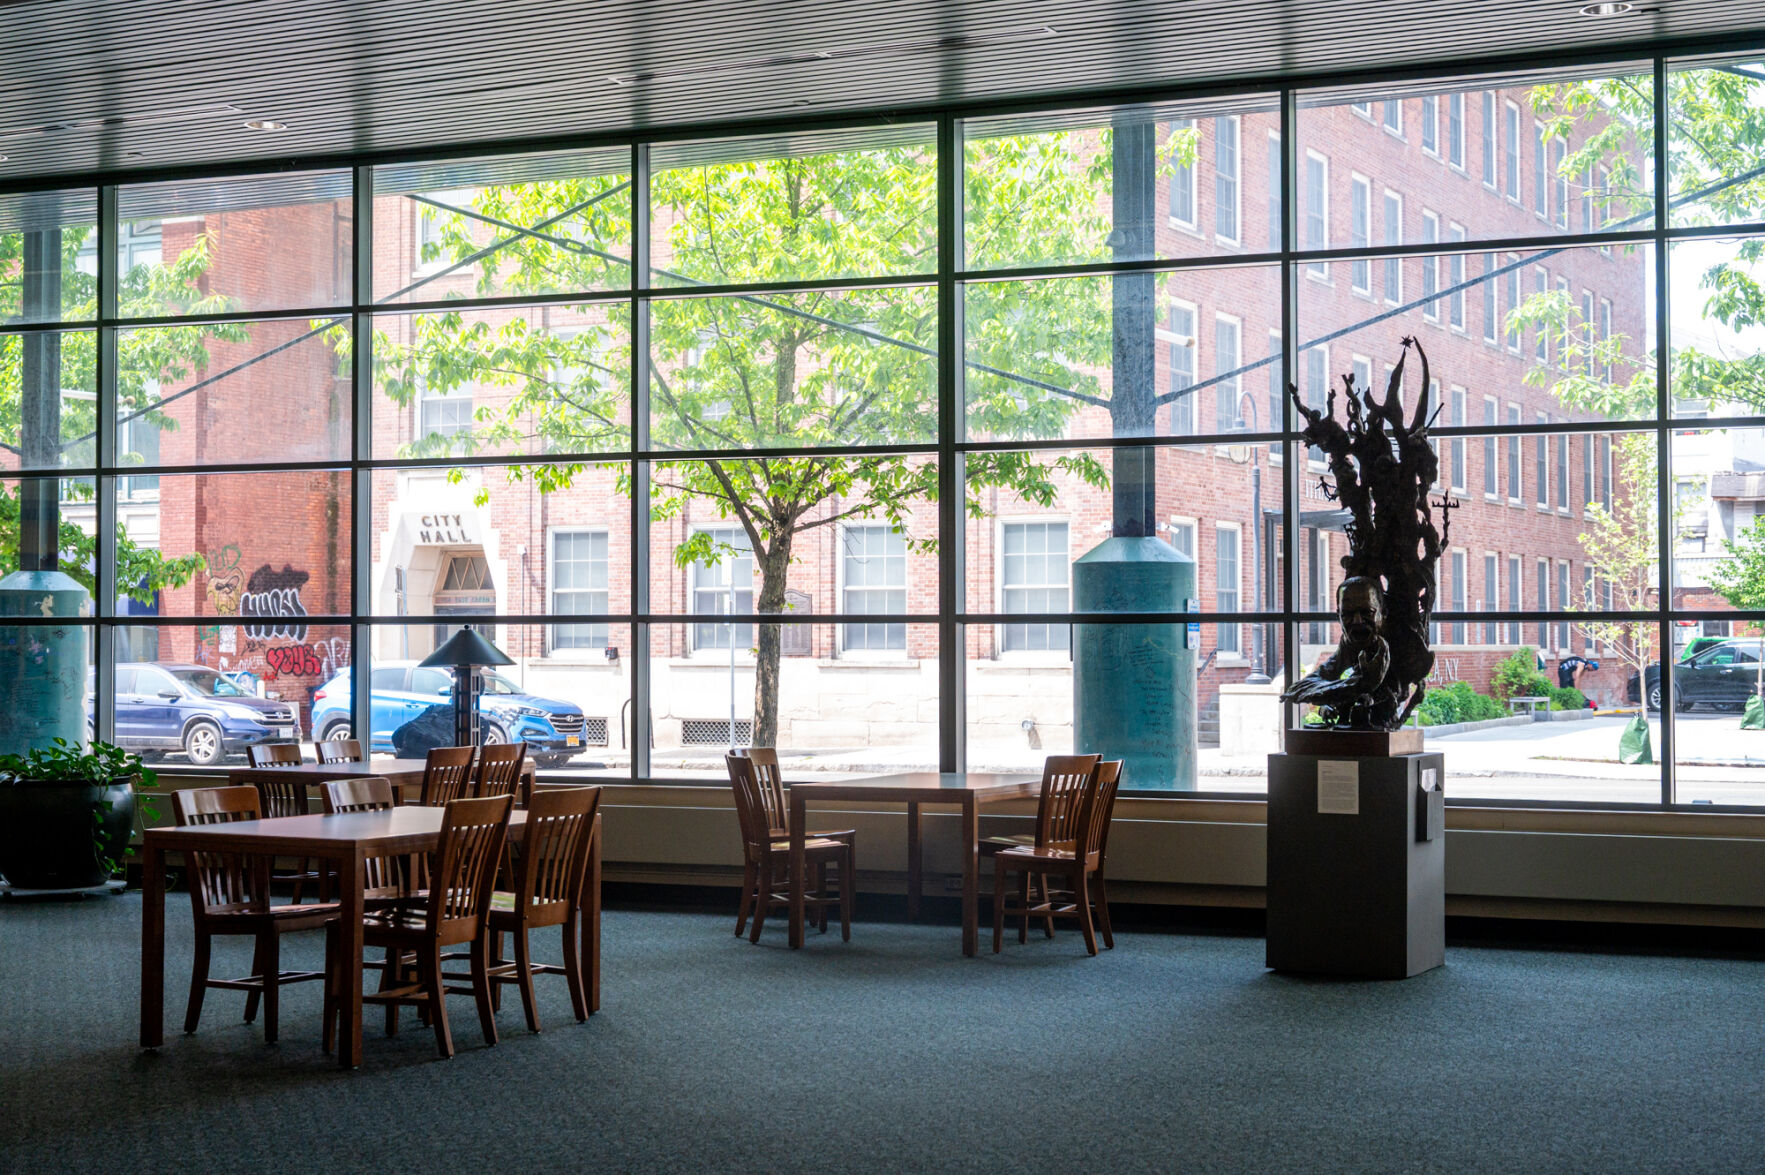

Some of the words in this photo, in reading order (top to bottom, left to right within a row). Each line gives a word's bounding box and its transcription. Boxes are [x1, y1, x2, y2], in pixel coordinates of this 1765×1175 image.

[421, 514, 462, 527] CITY
[420, 529, 472, 543] HALL
[1445, 658, 1459, 681] NY
